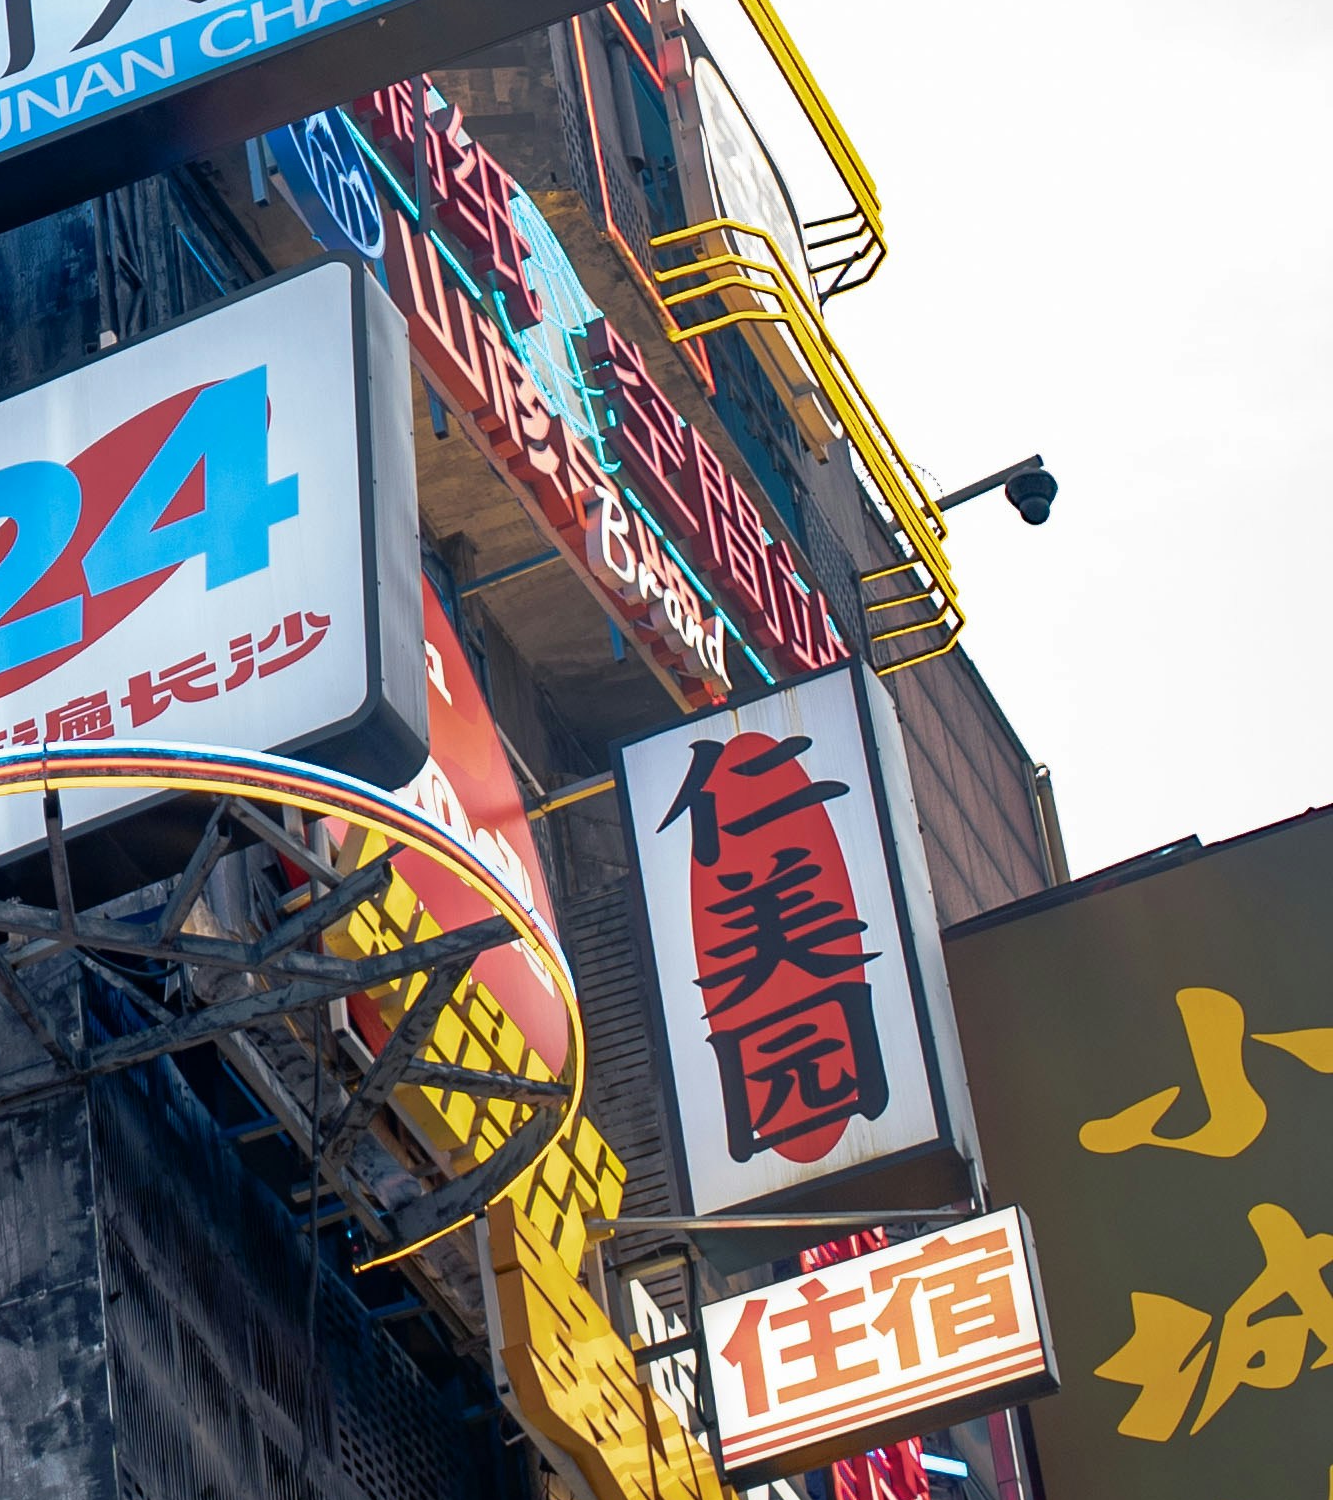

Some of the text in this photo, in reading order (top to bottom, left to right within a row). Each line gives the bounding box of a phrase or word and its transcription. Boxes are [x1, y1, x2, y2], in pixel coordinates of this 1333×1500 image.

[592, 484, 735, 692] Brand
[656, 730, 890, 1165] 仁美园
[719, 1225, 1023, 1420] 住宿
